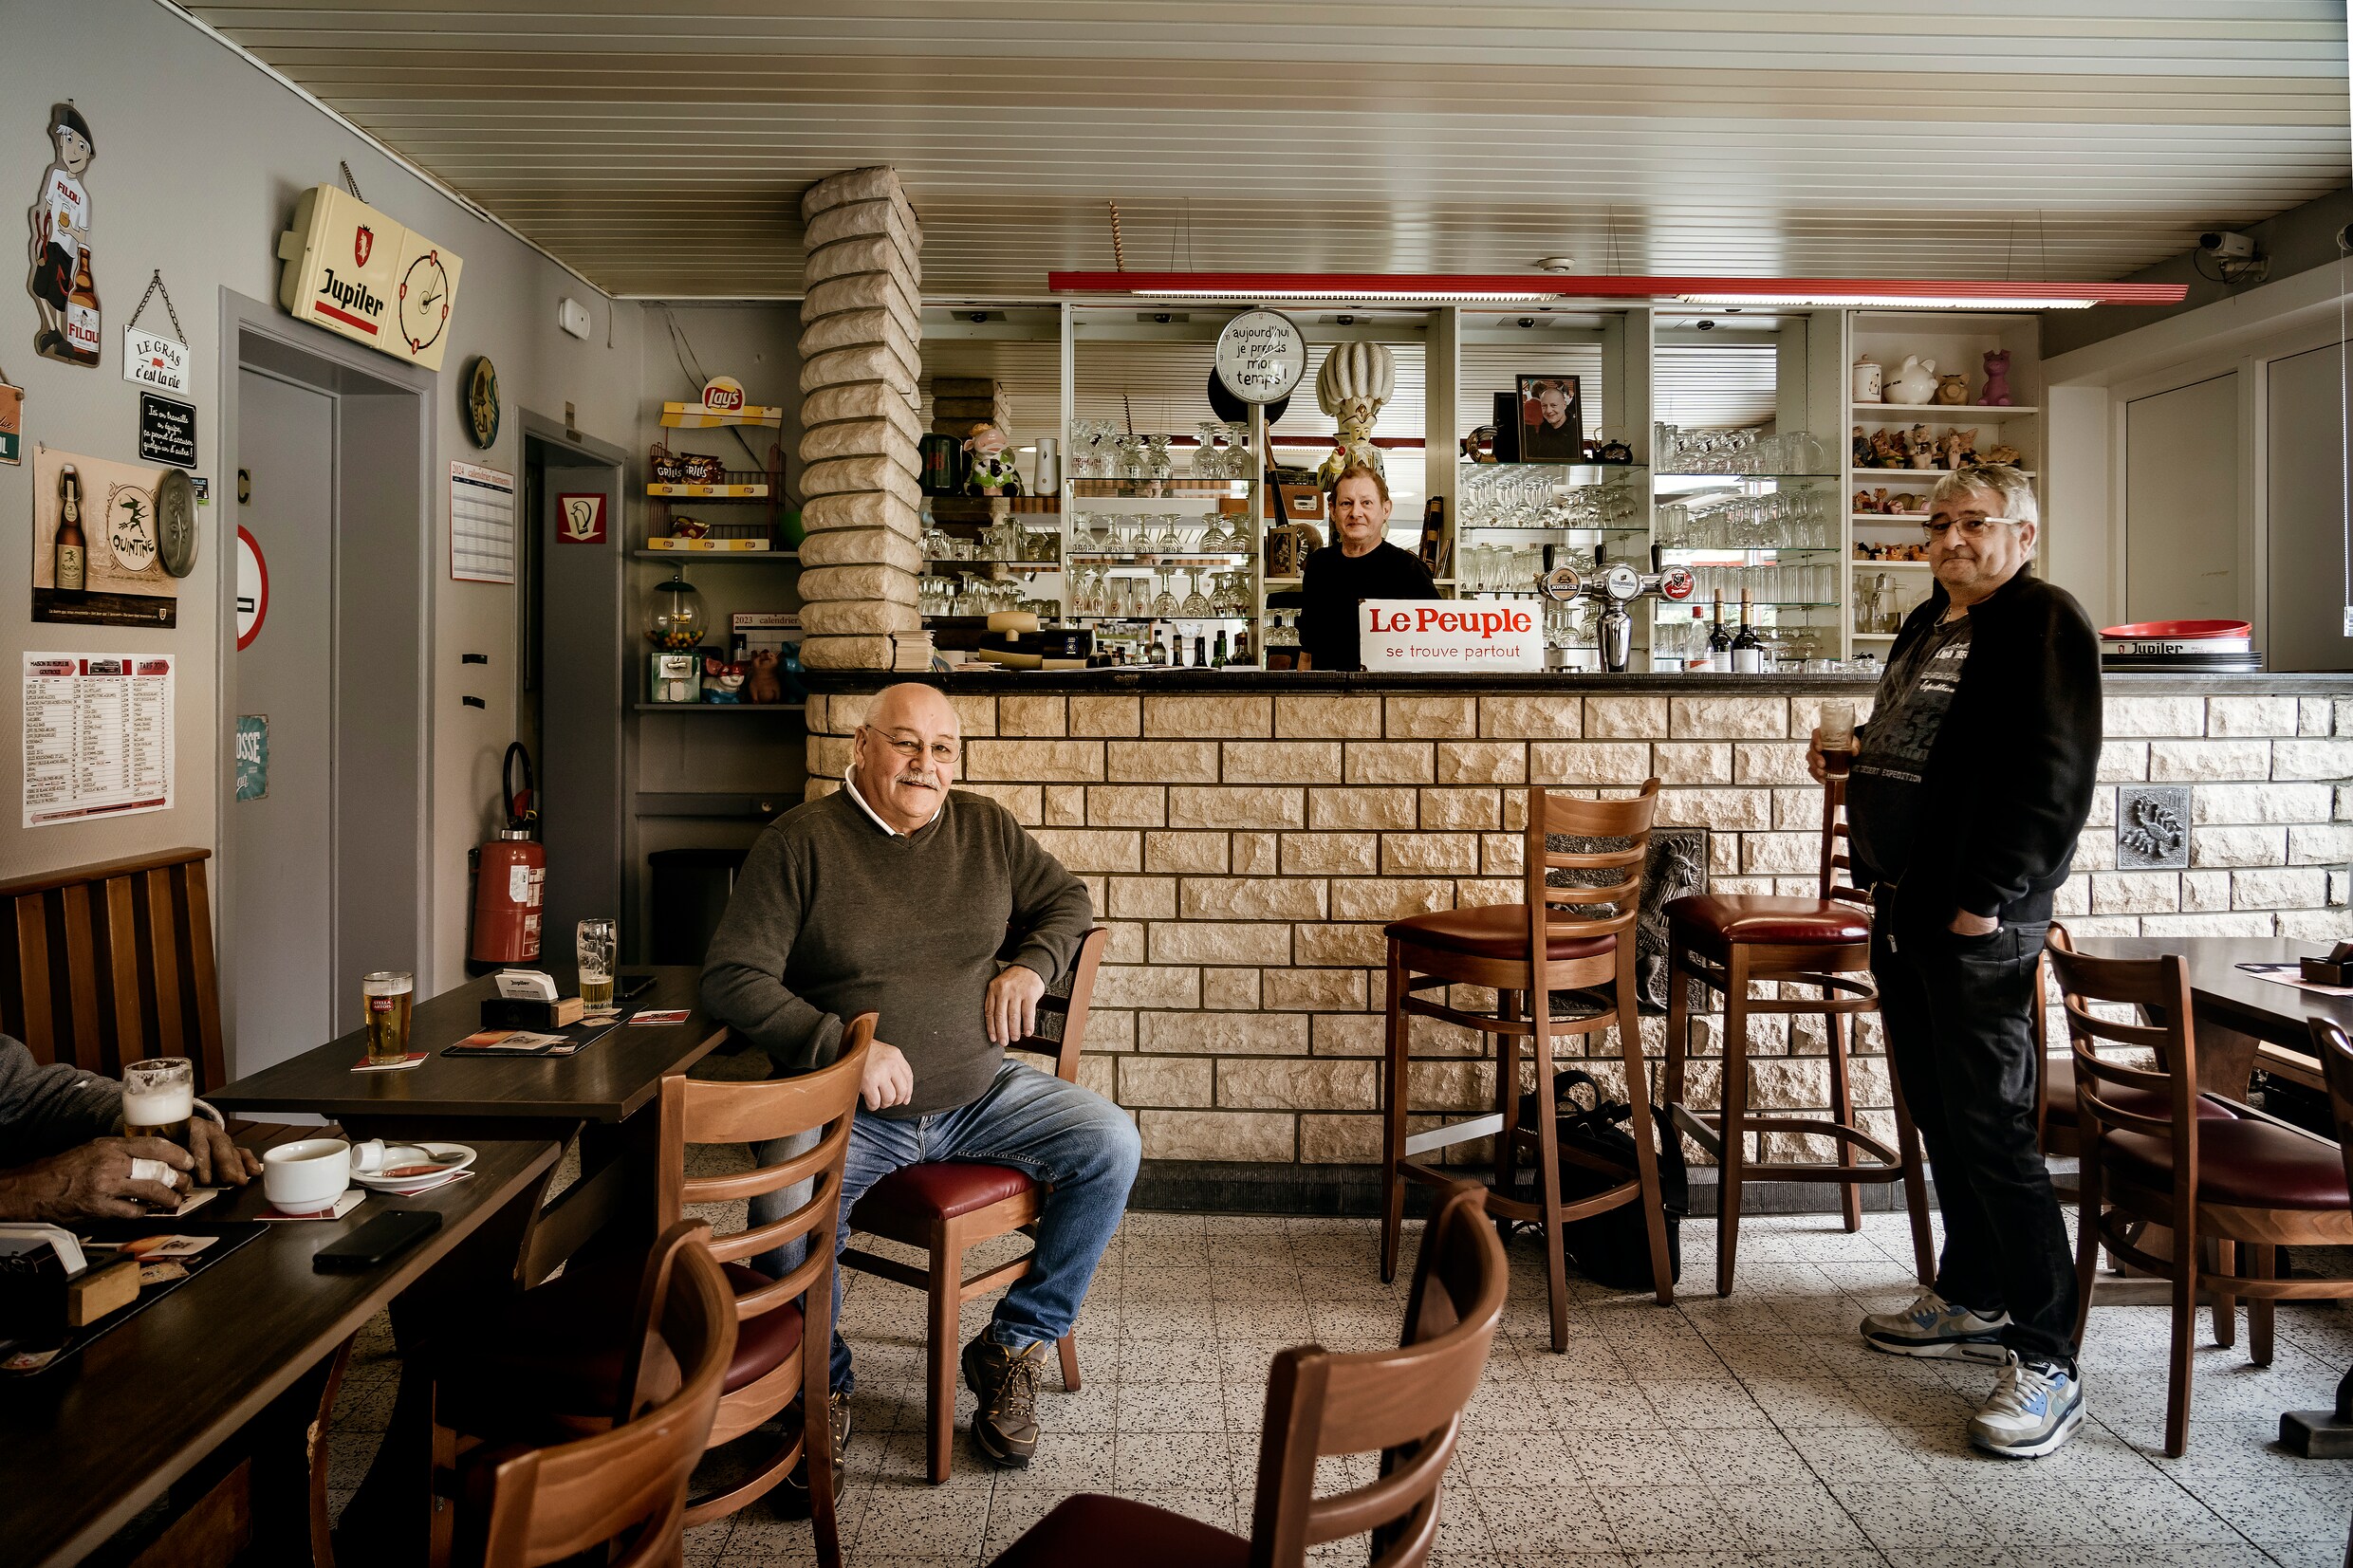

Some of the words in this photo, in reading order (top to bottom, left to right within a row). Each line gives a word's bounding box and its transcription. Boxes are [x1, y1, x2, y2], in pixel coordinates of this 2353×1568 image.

[57, 180, 81, 206] FILOU
[319, 268, 383, 317] Jupiler
[68, 322, 99, 344] FILOU
[1232, 324, 1289, 342] aujourd'hui
[137, 341, 152, 355] LE
[154, 341, 181, 366] GRAS
[1236, 341, 1247, 358] je
[136, 364, 157, 381] c'est
[157, 371, 167, 385] la
[168, 375, 181, 389] vie
[708, 389, 739, 409] Lay's
[658, 465, 683, 477] GRILLS
[113, 534, 155, 558] QUINTINE
[759, 616, 799, 624] calendrier
[1369, 608, 1411, 633] Le
[1415, 608, 1532, 638] Peuple
[1386, 647, 1403, 657] se
[1410, 645, 1458, 657] trouve
[1465, 645, 1520, 660] partout
[1881, 768, 1922, 783] EXPEDITION
